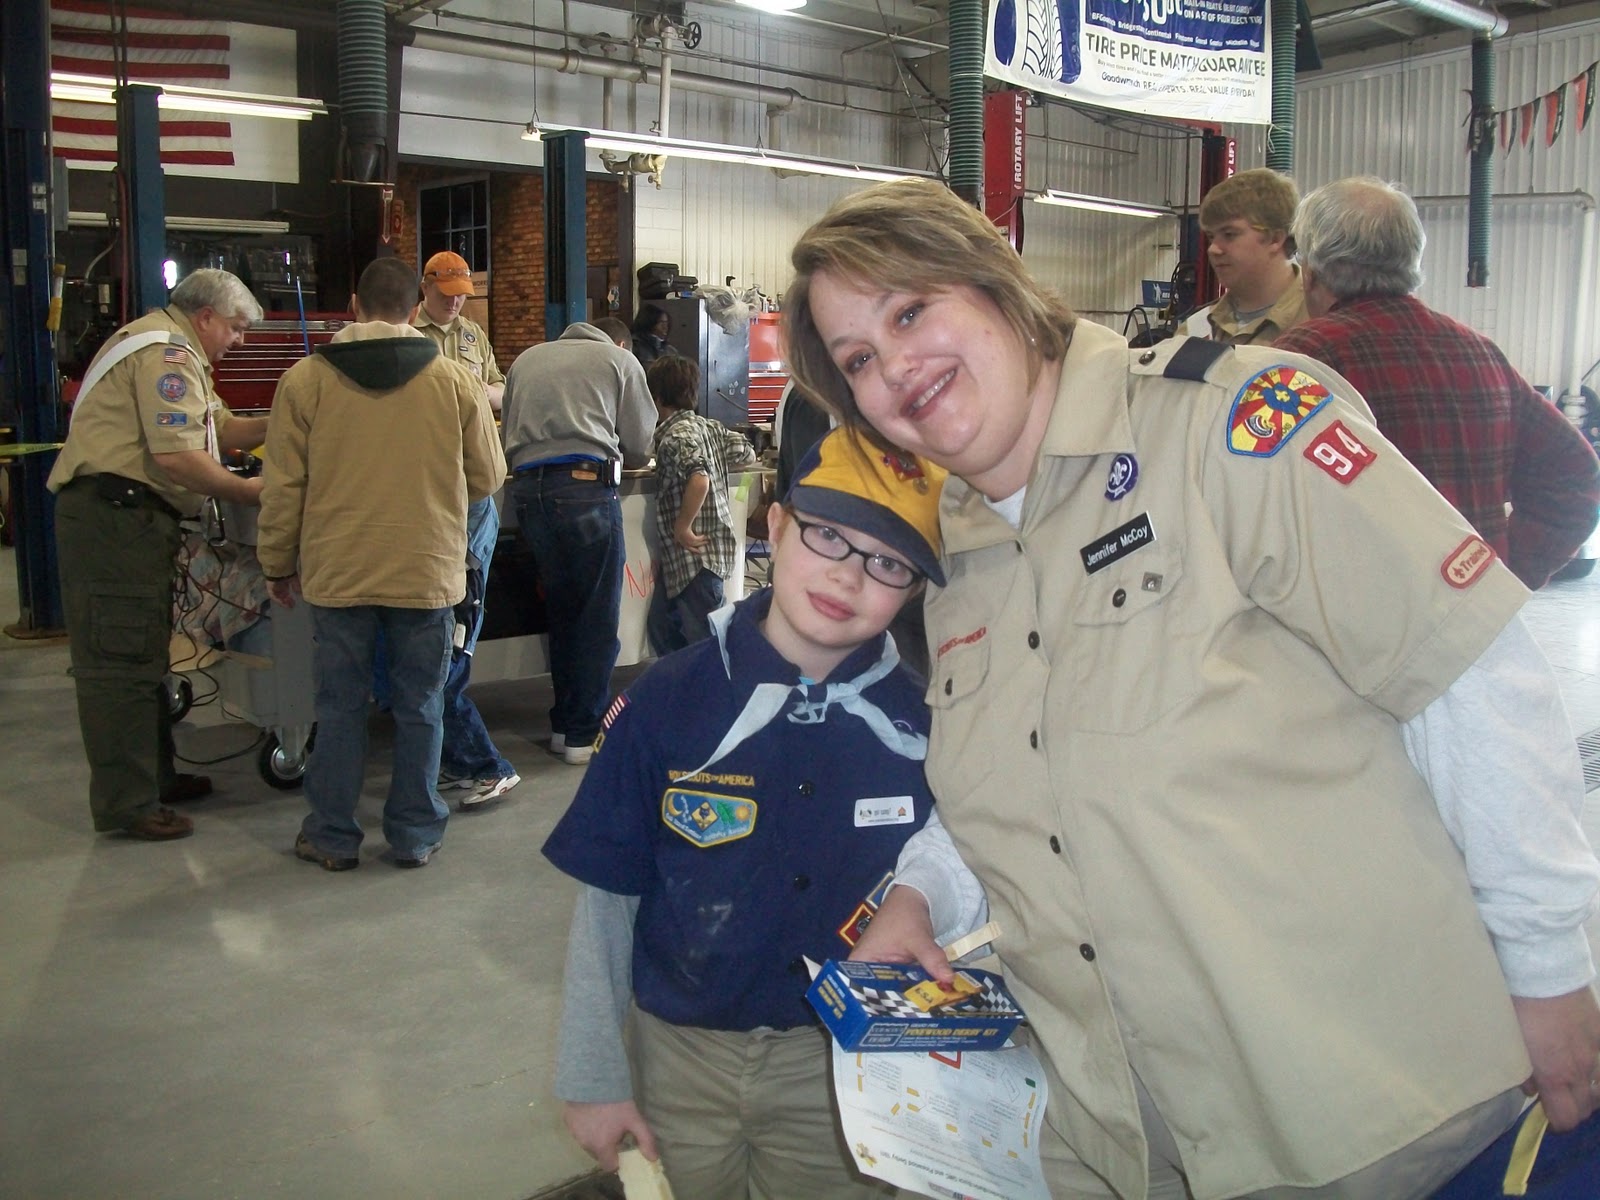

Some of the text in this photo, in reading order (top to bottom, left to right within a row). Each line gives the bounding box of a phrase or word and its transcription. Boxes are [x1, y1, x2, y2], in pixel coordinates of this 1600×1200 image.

[1183, 9, 1195, 20] ON
[1085, 32, 1267, 78] TIRE PRICE MATCH GUARANTEE
[1014, 93, 1023, 183] ROTARY LIFT
[1313, 427, 1368, 476] 94
[1086, 525, 1148, 567] Jennifer McCoy
[1459, 543, 1488, 572] Trained
[717, 773, 755, 787] AMERICA
